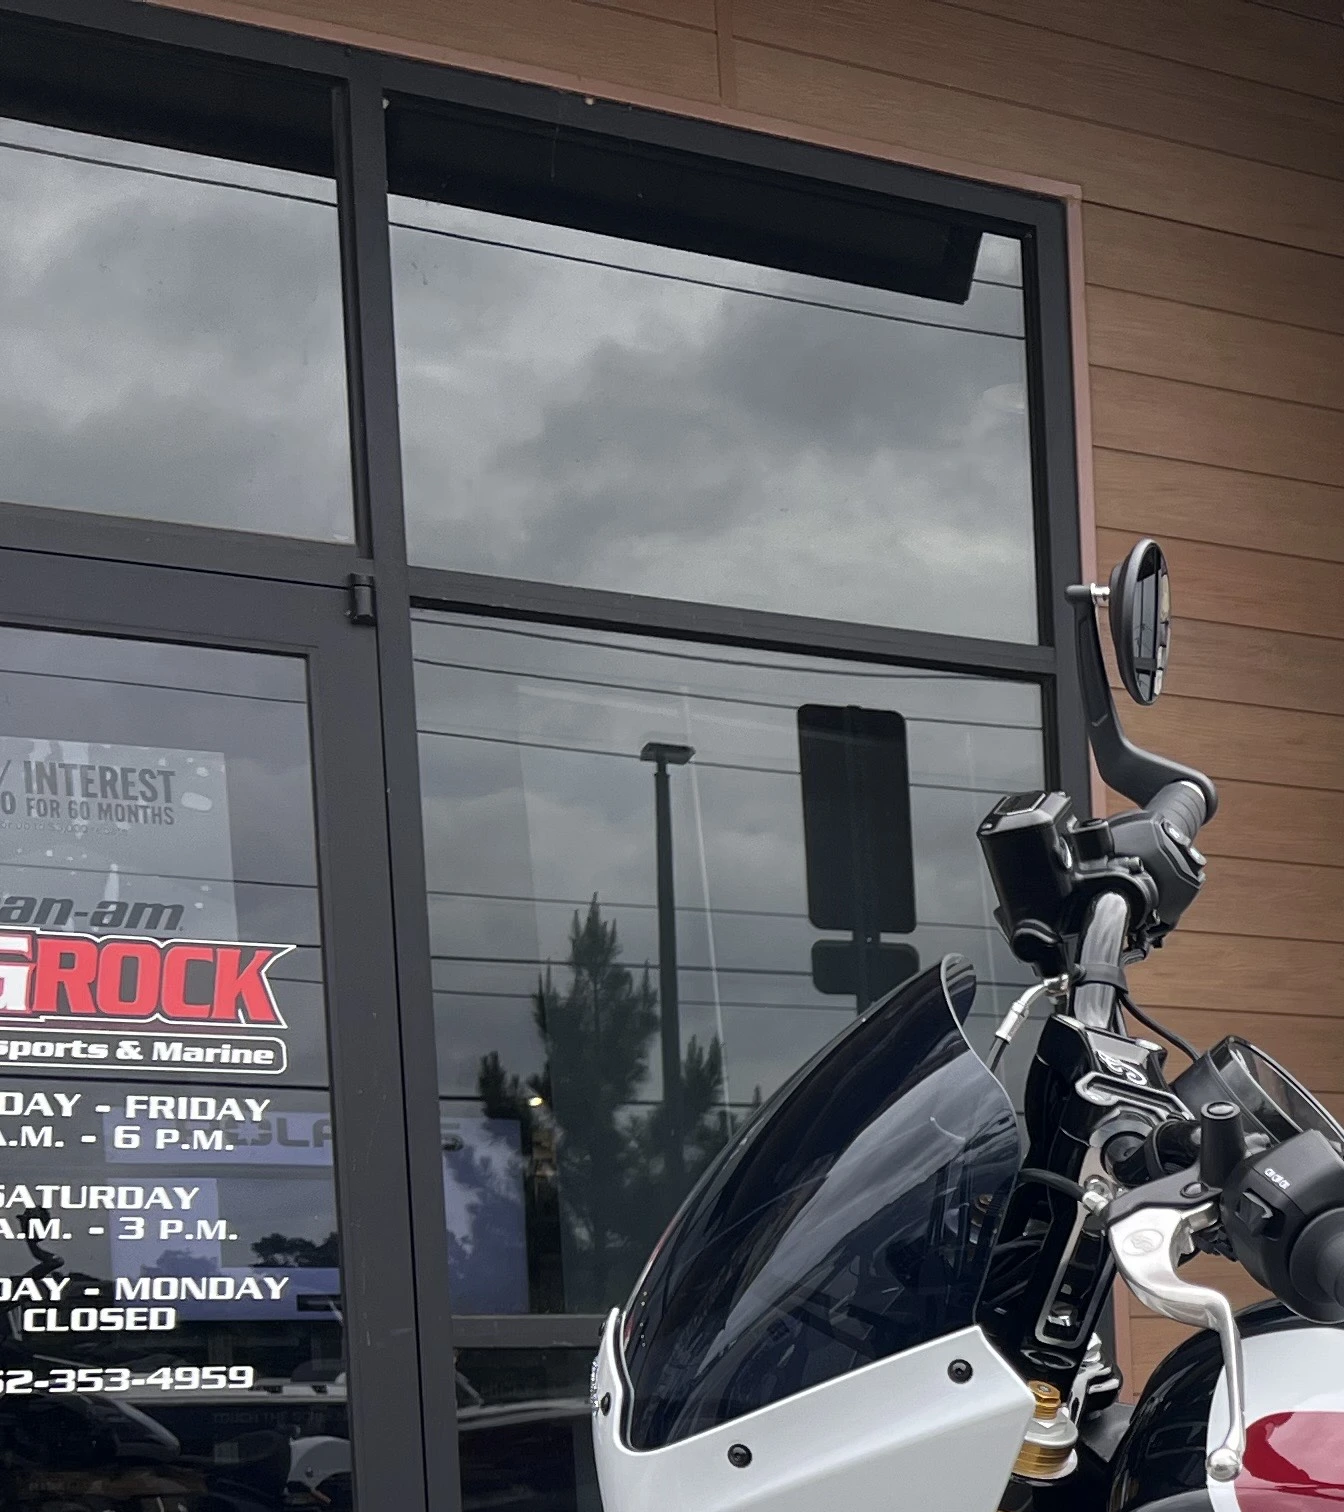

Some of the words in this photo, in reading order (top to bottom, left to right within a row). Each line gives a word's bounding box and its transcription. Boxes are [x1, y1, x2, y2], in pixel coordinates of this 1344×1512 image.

[23, 760, 176, 804] INTEREST
[26, 797, 60, 819] FOR
[67, 800, 90, 820] 60
[98, 801, 175, 825] MONTHS
[115, 1040, 143, 1060] &
[152, 1041, 275, 1066] Marine
[125, 1095, 271, 1122] FRIDAY
[0, 1125, 65, 1148] .M.
[113, 1125, 141, 1149] 6
[155, 1128, 235, 1151] P.M.
[0, 1184, 200, 1210] ATURDAY
[118, 1217, 145, 1241] 3
[160, 1219, 239, 1241] P.M.
[115, 1277, 289, 1301] MONDAY
[23, 1307, 177, 1332] CLOSED
[0, 1366, 254, 1393] 2-353-4959
